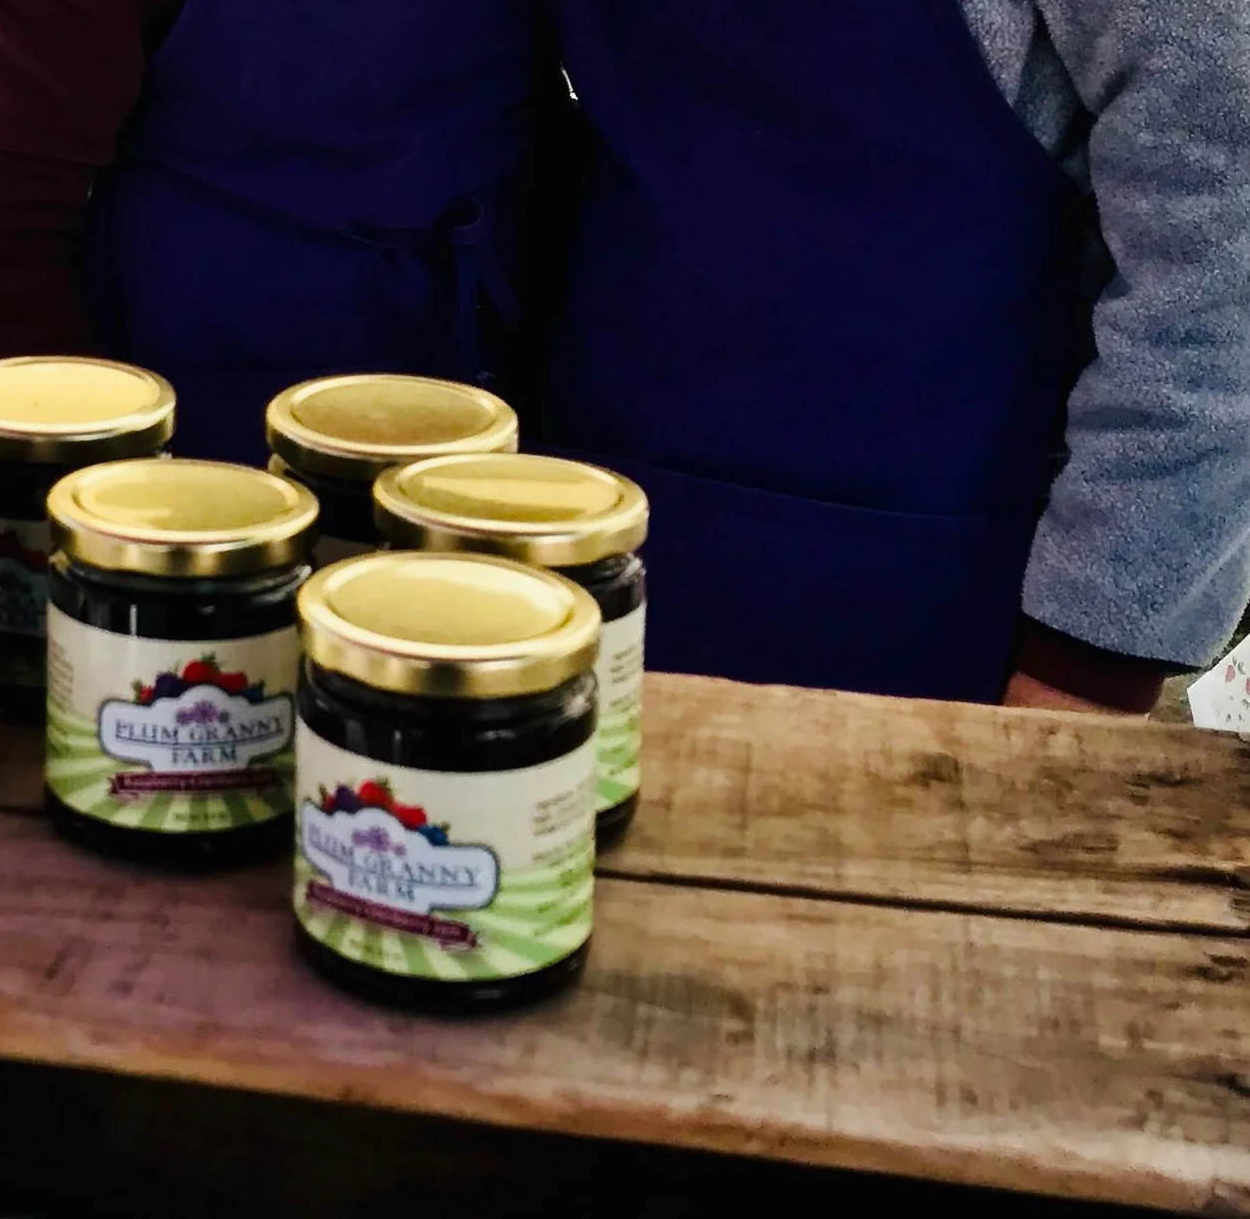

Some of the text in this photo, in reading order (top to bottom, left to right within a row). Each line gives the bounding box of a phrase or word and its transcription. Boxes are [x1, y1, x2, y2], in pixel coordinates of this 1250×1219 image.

[115, 715, 285, 742] PLUM GRANNY
[172, 746, 238, 765] FARM
[363, 855, 482, 887] GRANNY
